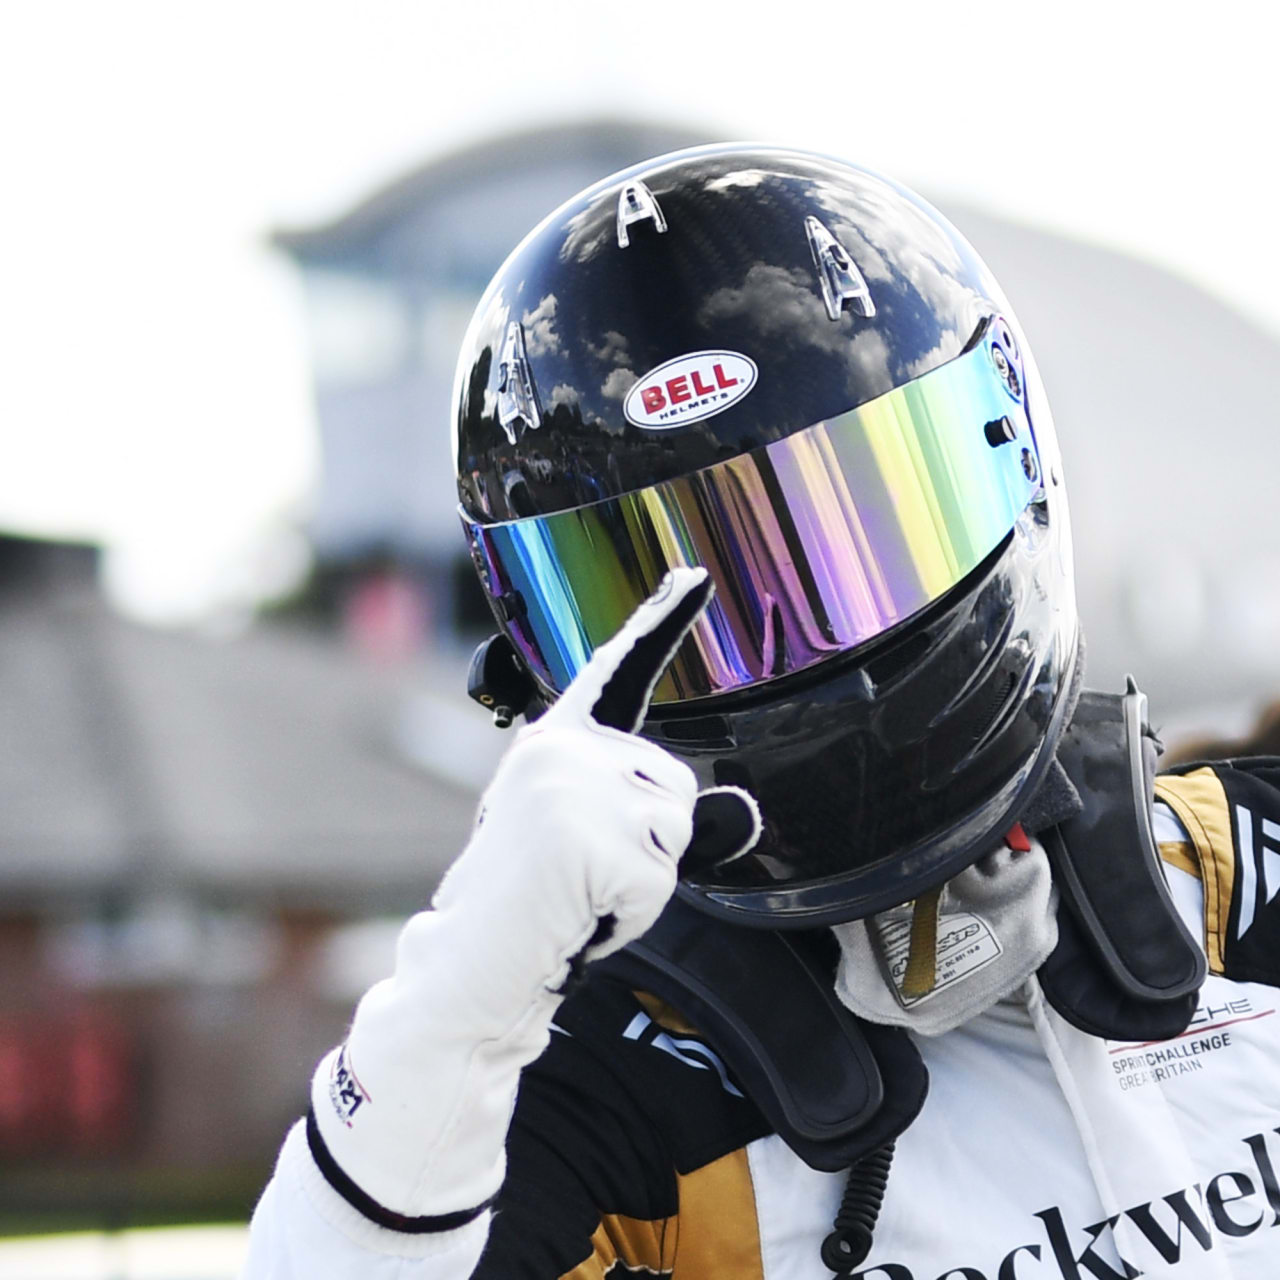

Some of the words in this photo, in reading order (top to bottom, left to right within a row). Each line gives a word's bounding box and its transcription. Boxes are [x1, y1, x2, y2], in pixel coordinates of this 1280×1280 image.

[640, 363, 739, 416] BELL
[659, 392, 729, 421] HELMETS
[1145, 1032, 1232, 1067] CHALLENGE
[1119, 1069, 1150, 1092] GREA
